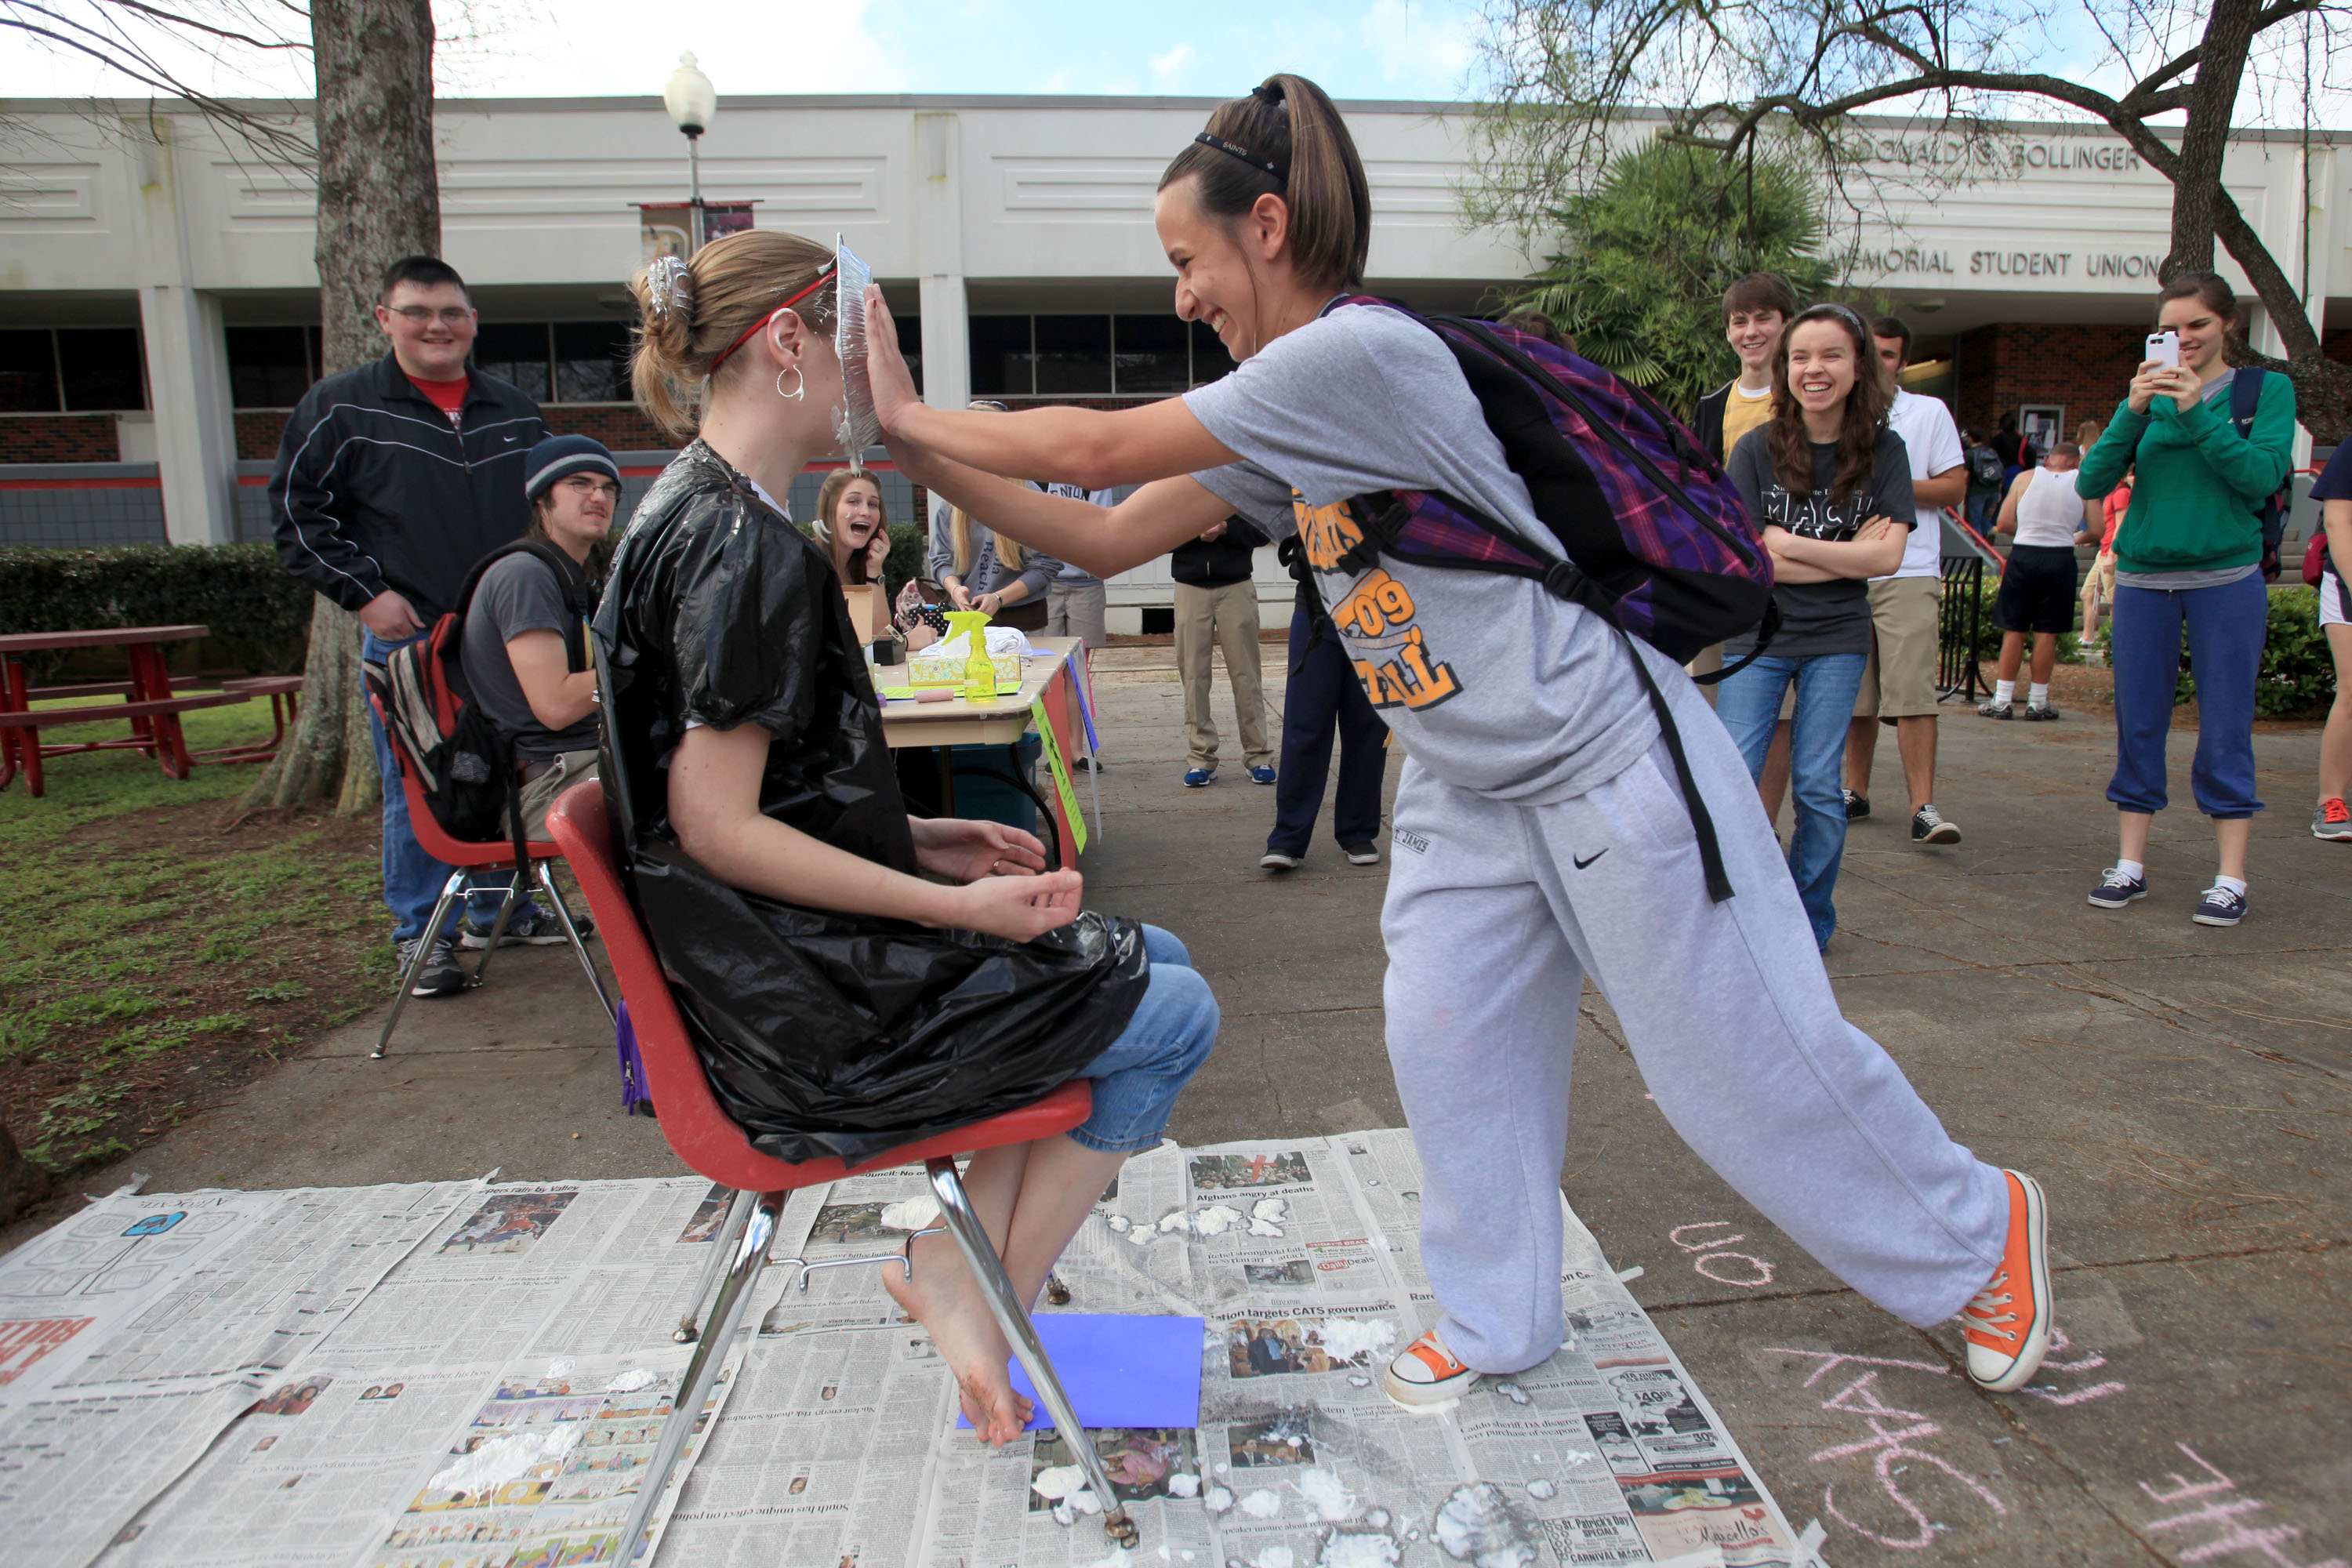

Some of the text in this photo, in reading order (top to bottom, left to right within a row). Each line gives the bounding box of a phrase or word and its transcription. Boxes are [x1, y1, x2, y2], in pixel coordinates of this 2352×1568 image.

[2011, 144, 2141, 170] BOLLINGER
[1828, 247, 2160, 278] MEMORIAL STUDENT UNION
[978, 540, 994, 590] Beach
[1403, 833, 1428, 853] JAMES
[1196, 1192, 1237, 1202] Afghans
[1240, 1190, 1268, 1200] angry
[1282, 1185, 1315, 1194] deaths
[1208, 1252, 1233, 1261] Rebel
[1235, 1249, 1283, 1258] stronghold
[1220, 1257, 1251, 1266] Syrian
[1322, 1256, 1375, 1270] Daily Deals
[1247, 1307, 1290, 1319] targets
[1292, 1307, 1325, 1316] CATS
[1327, 1304, 1396, 1314] governance
[1595, 1339, 1647, 1348] ATTENTION
[1561, 1379, 1600, 1388] rankings
[796, 1410, 811, 1418] risk
[814, 1406, 841, 1417] energy
[1461, 1422, 1491, 1433] Caddo
[1493, 1420, 1523, 1429] sheriff,
[1542, 1417, 1579, 1428] disagree
[1464, 1432, 1486, 1441] over
[1486, 1429, 1527, 1439] purchase
[1541, 1427, 1581, 1436] weapons
[1693, 1432, 1719, 1443] 30%
[724, 1508, 753, 1519] effect
[755, 1506, 793, 1517] unique
[797, 1505, 815, 1515] has
[818, 1503, 849, 1513] South
[706, 1512, 720, 1520] on
[1562, 1515, 1630, 1530] St. Patrick's Day
[1254, 1524, 1283, 1533] unsure
[1285, 1520, 1309, 1531] about
[1310, 1516, 1353, 1528] retirement
[1354, 1516, 1368, 1525] pla
[1700, 1519, 1769, 1543] Marcello's
[1583, 1527, 1619, 1537] SPECIALS
[1570, 1549, 1645, 1563] CARNIVAL MART
